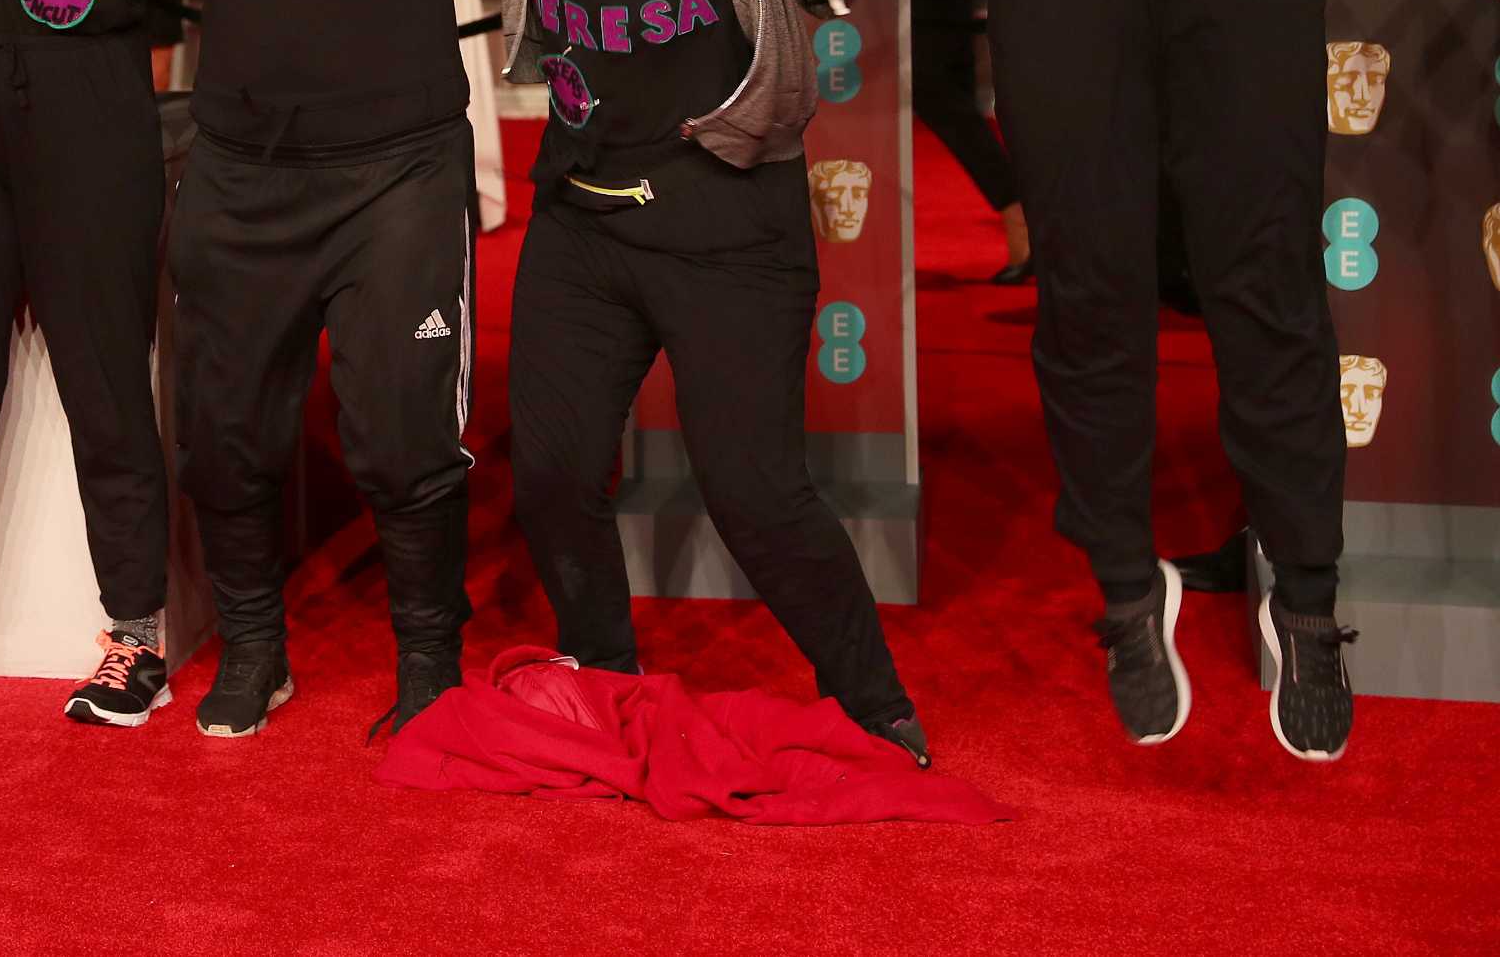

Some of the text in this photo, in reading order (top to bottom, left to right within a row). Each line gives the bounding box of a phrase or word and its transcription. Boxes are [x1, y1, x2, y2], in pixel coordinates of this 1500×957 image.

[829, 31, 845, 91] EE
[1341, 211, 1358, 278] EE
[414, 327, 451, 340] adidas
[833, 312, 850, 373] EE
